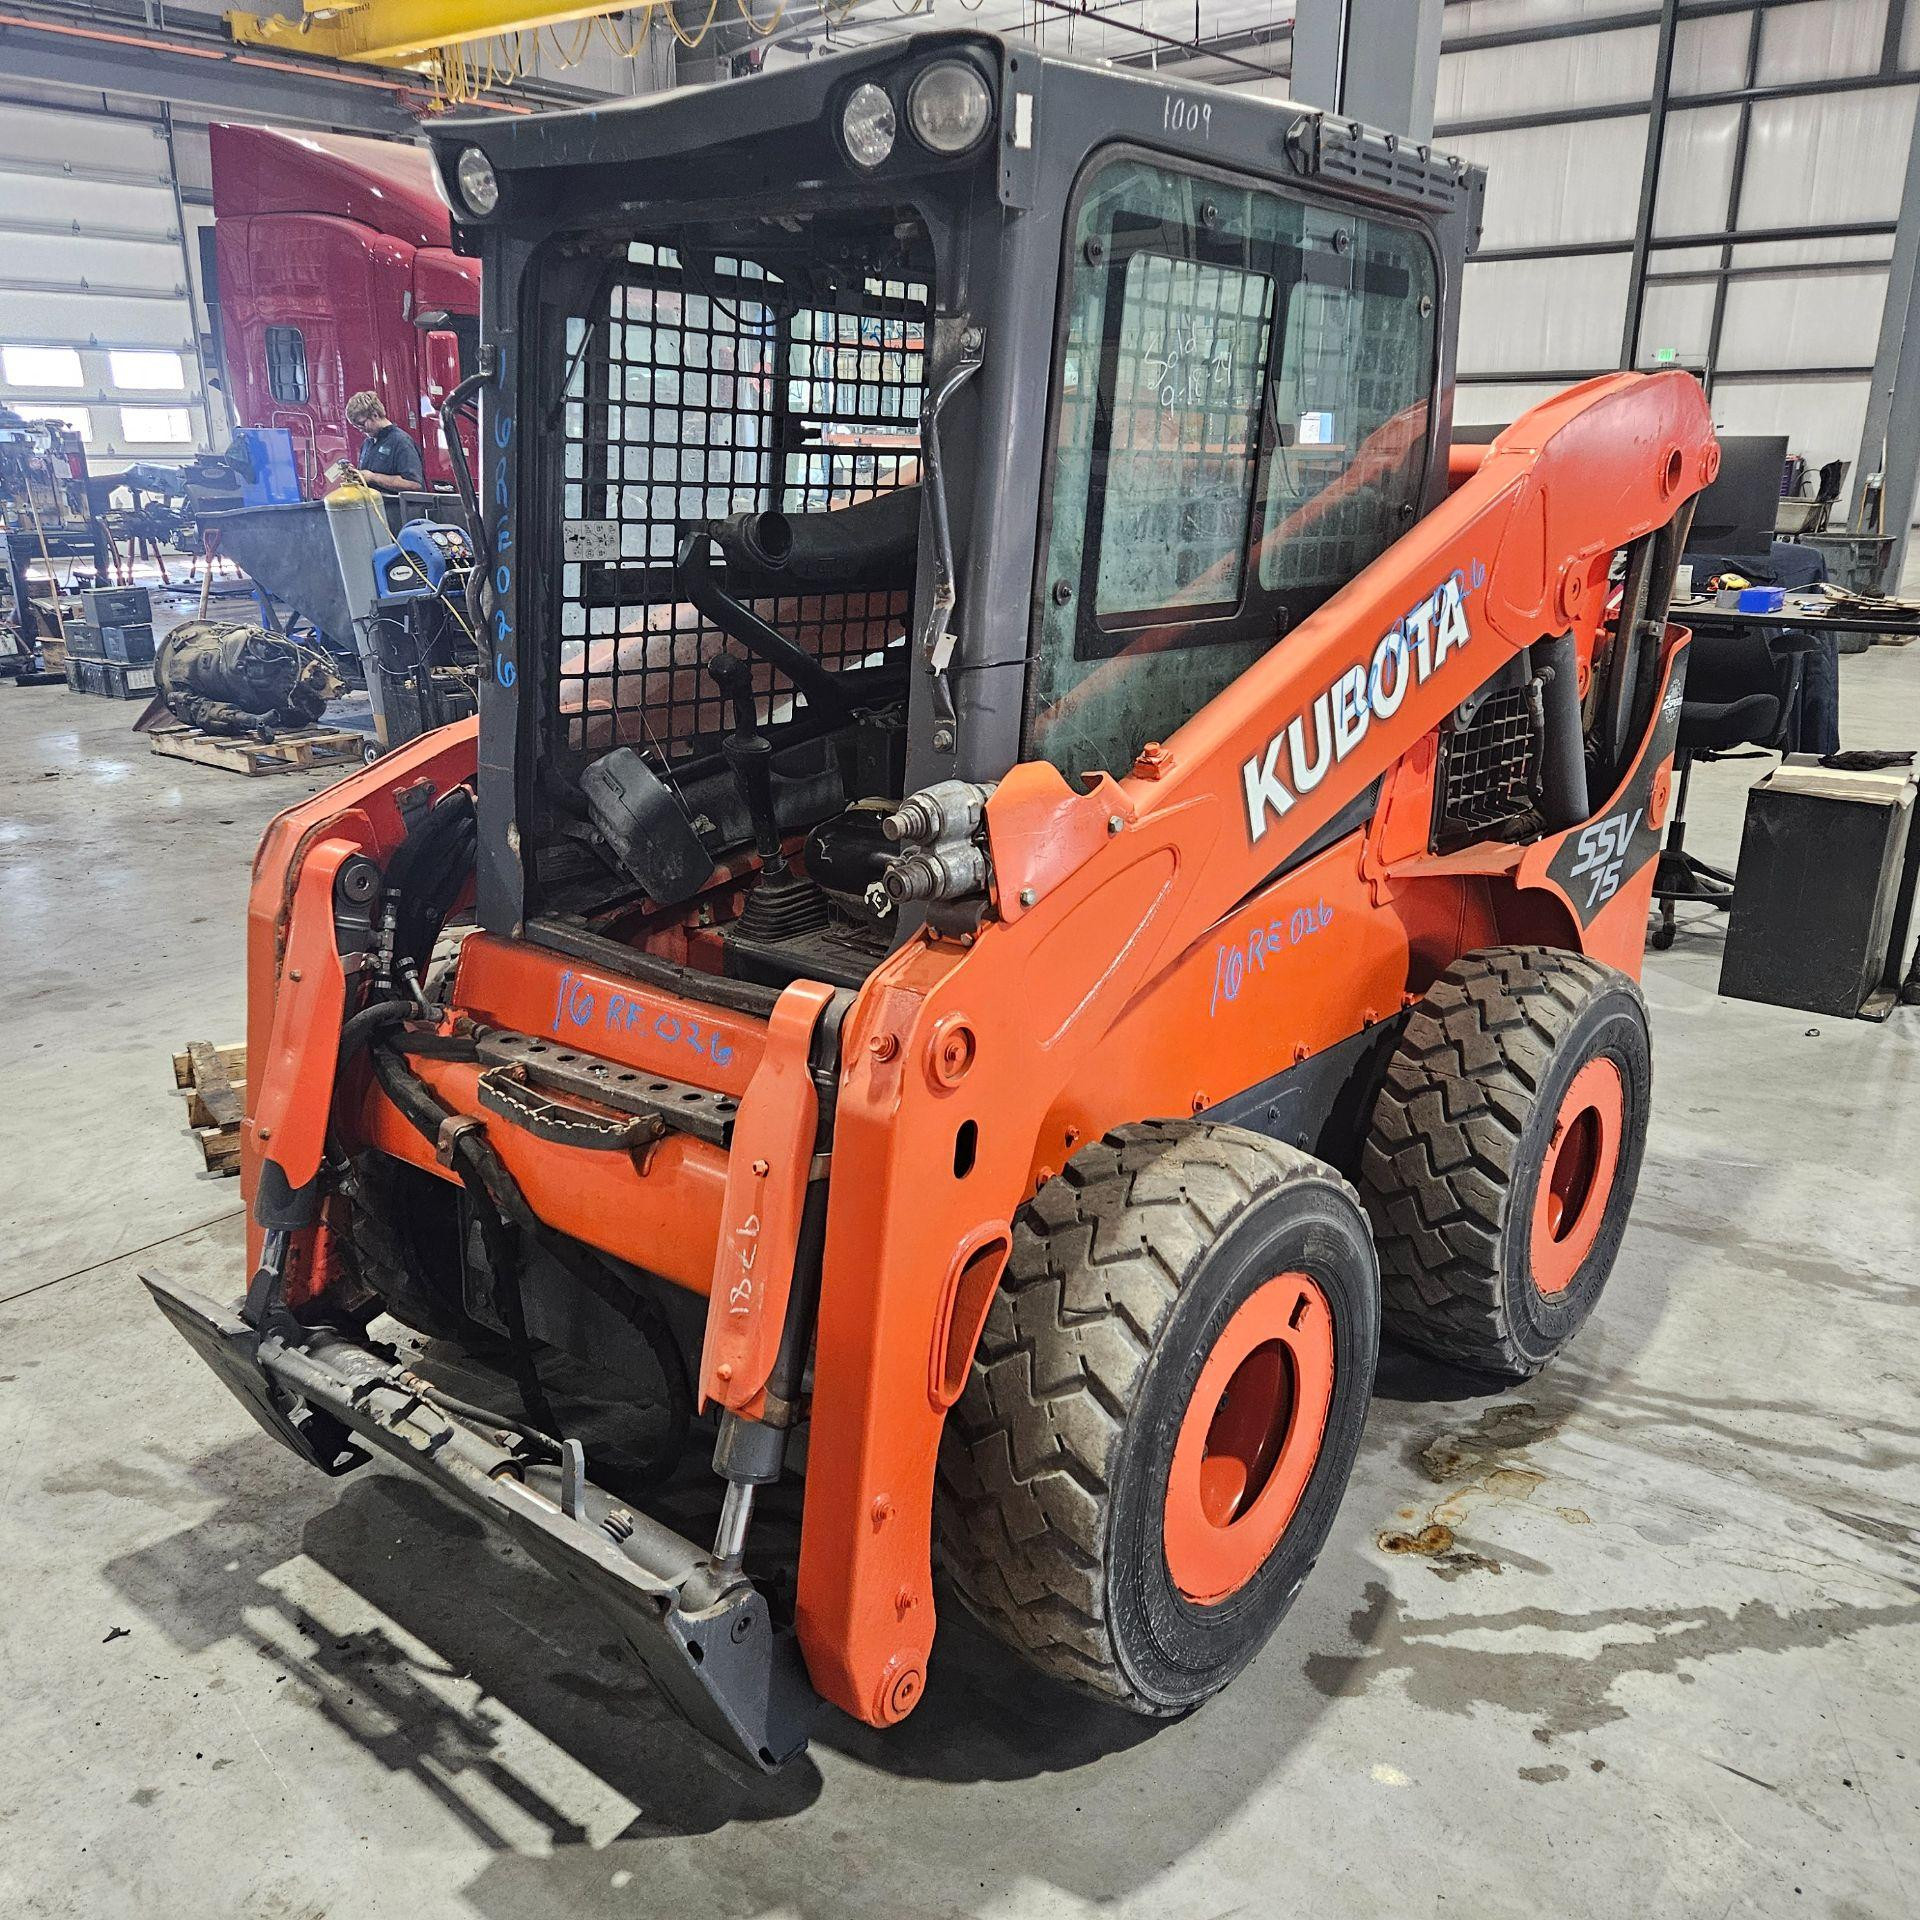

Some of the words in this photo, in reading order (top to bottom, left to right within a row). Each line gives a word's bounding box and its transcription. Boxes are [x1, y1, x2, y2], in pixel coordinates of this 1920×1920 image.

[1163, 95, 1213, 140] 1009
[1144, 320, 1198, 390] Sold
[1242, 575, 1472, 844] KUBOTA
[1570, 807, 1644, 878] SSV
[1585, 858, 1625, 909] 75
